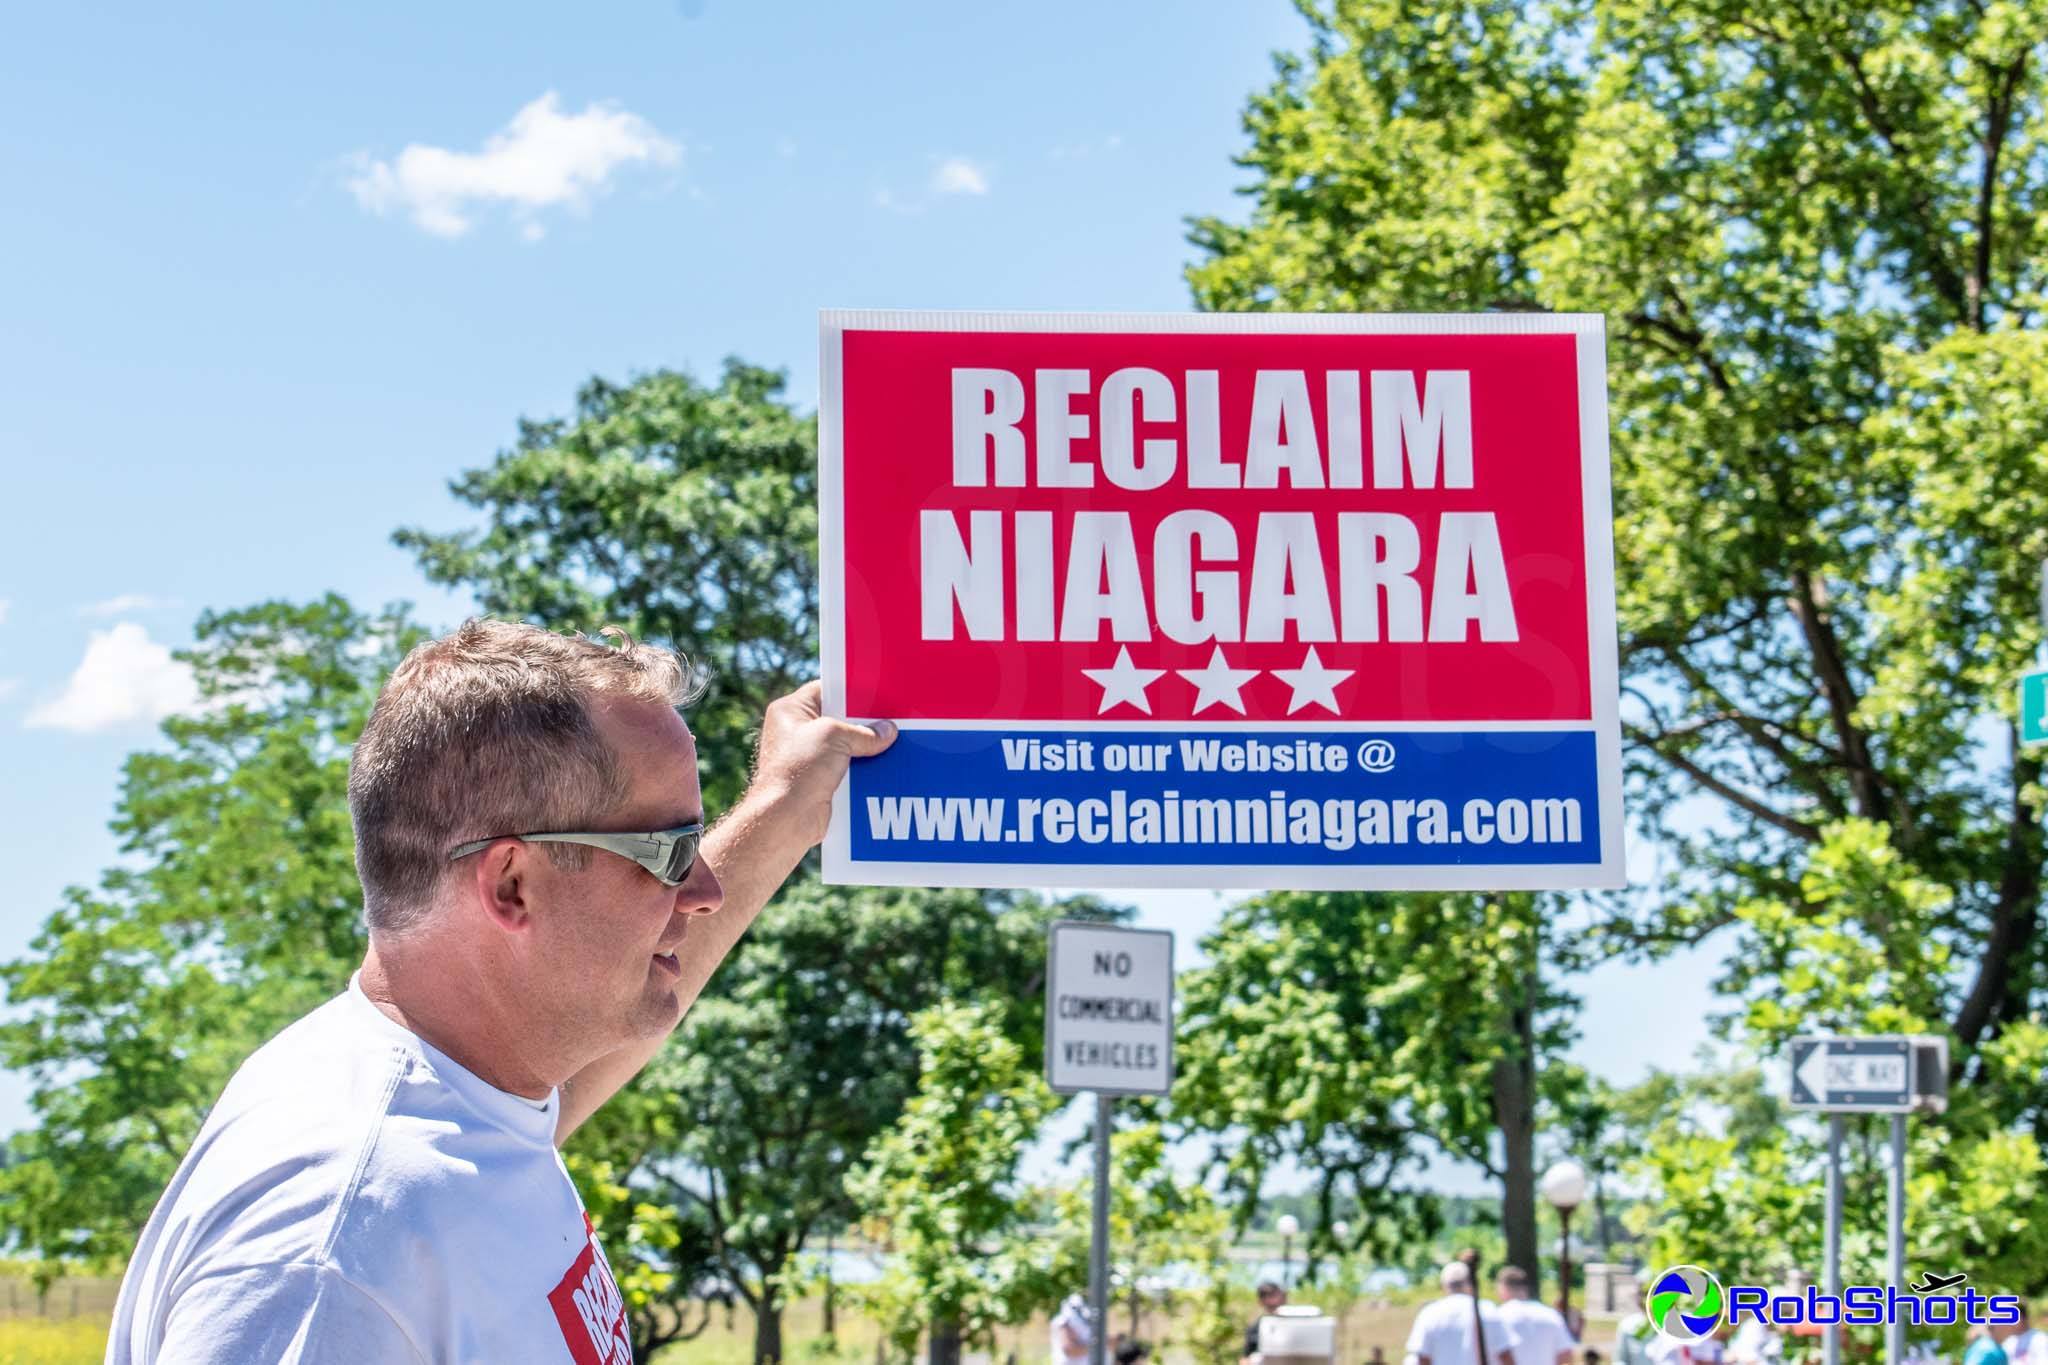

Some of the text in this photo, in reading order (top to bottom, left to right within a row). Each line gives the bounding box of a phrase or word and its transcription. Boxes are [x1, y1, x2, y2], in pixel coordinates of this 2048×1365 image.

[951, 366, 1475, 491] RECLAIM
[919, 508, 1520, 646] NIAGARA
[1001, 738, 1396, 774] Visit our Website @
[866, 789, 1583, 851] www.reclaimniagara.com
[1093, 951, 1132, 978] NO
[1058, 995, 1162, 1024] COMMERCIAL
[1064, 1041, 1157, 1069] VEHICLES
[1826, 1058, 1900, 1087] ONE WAY
